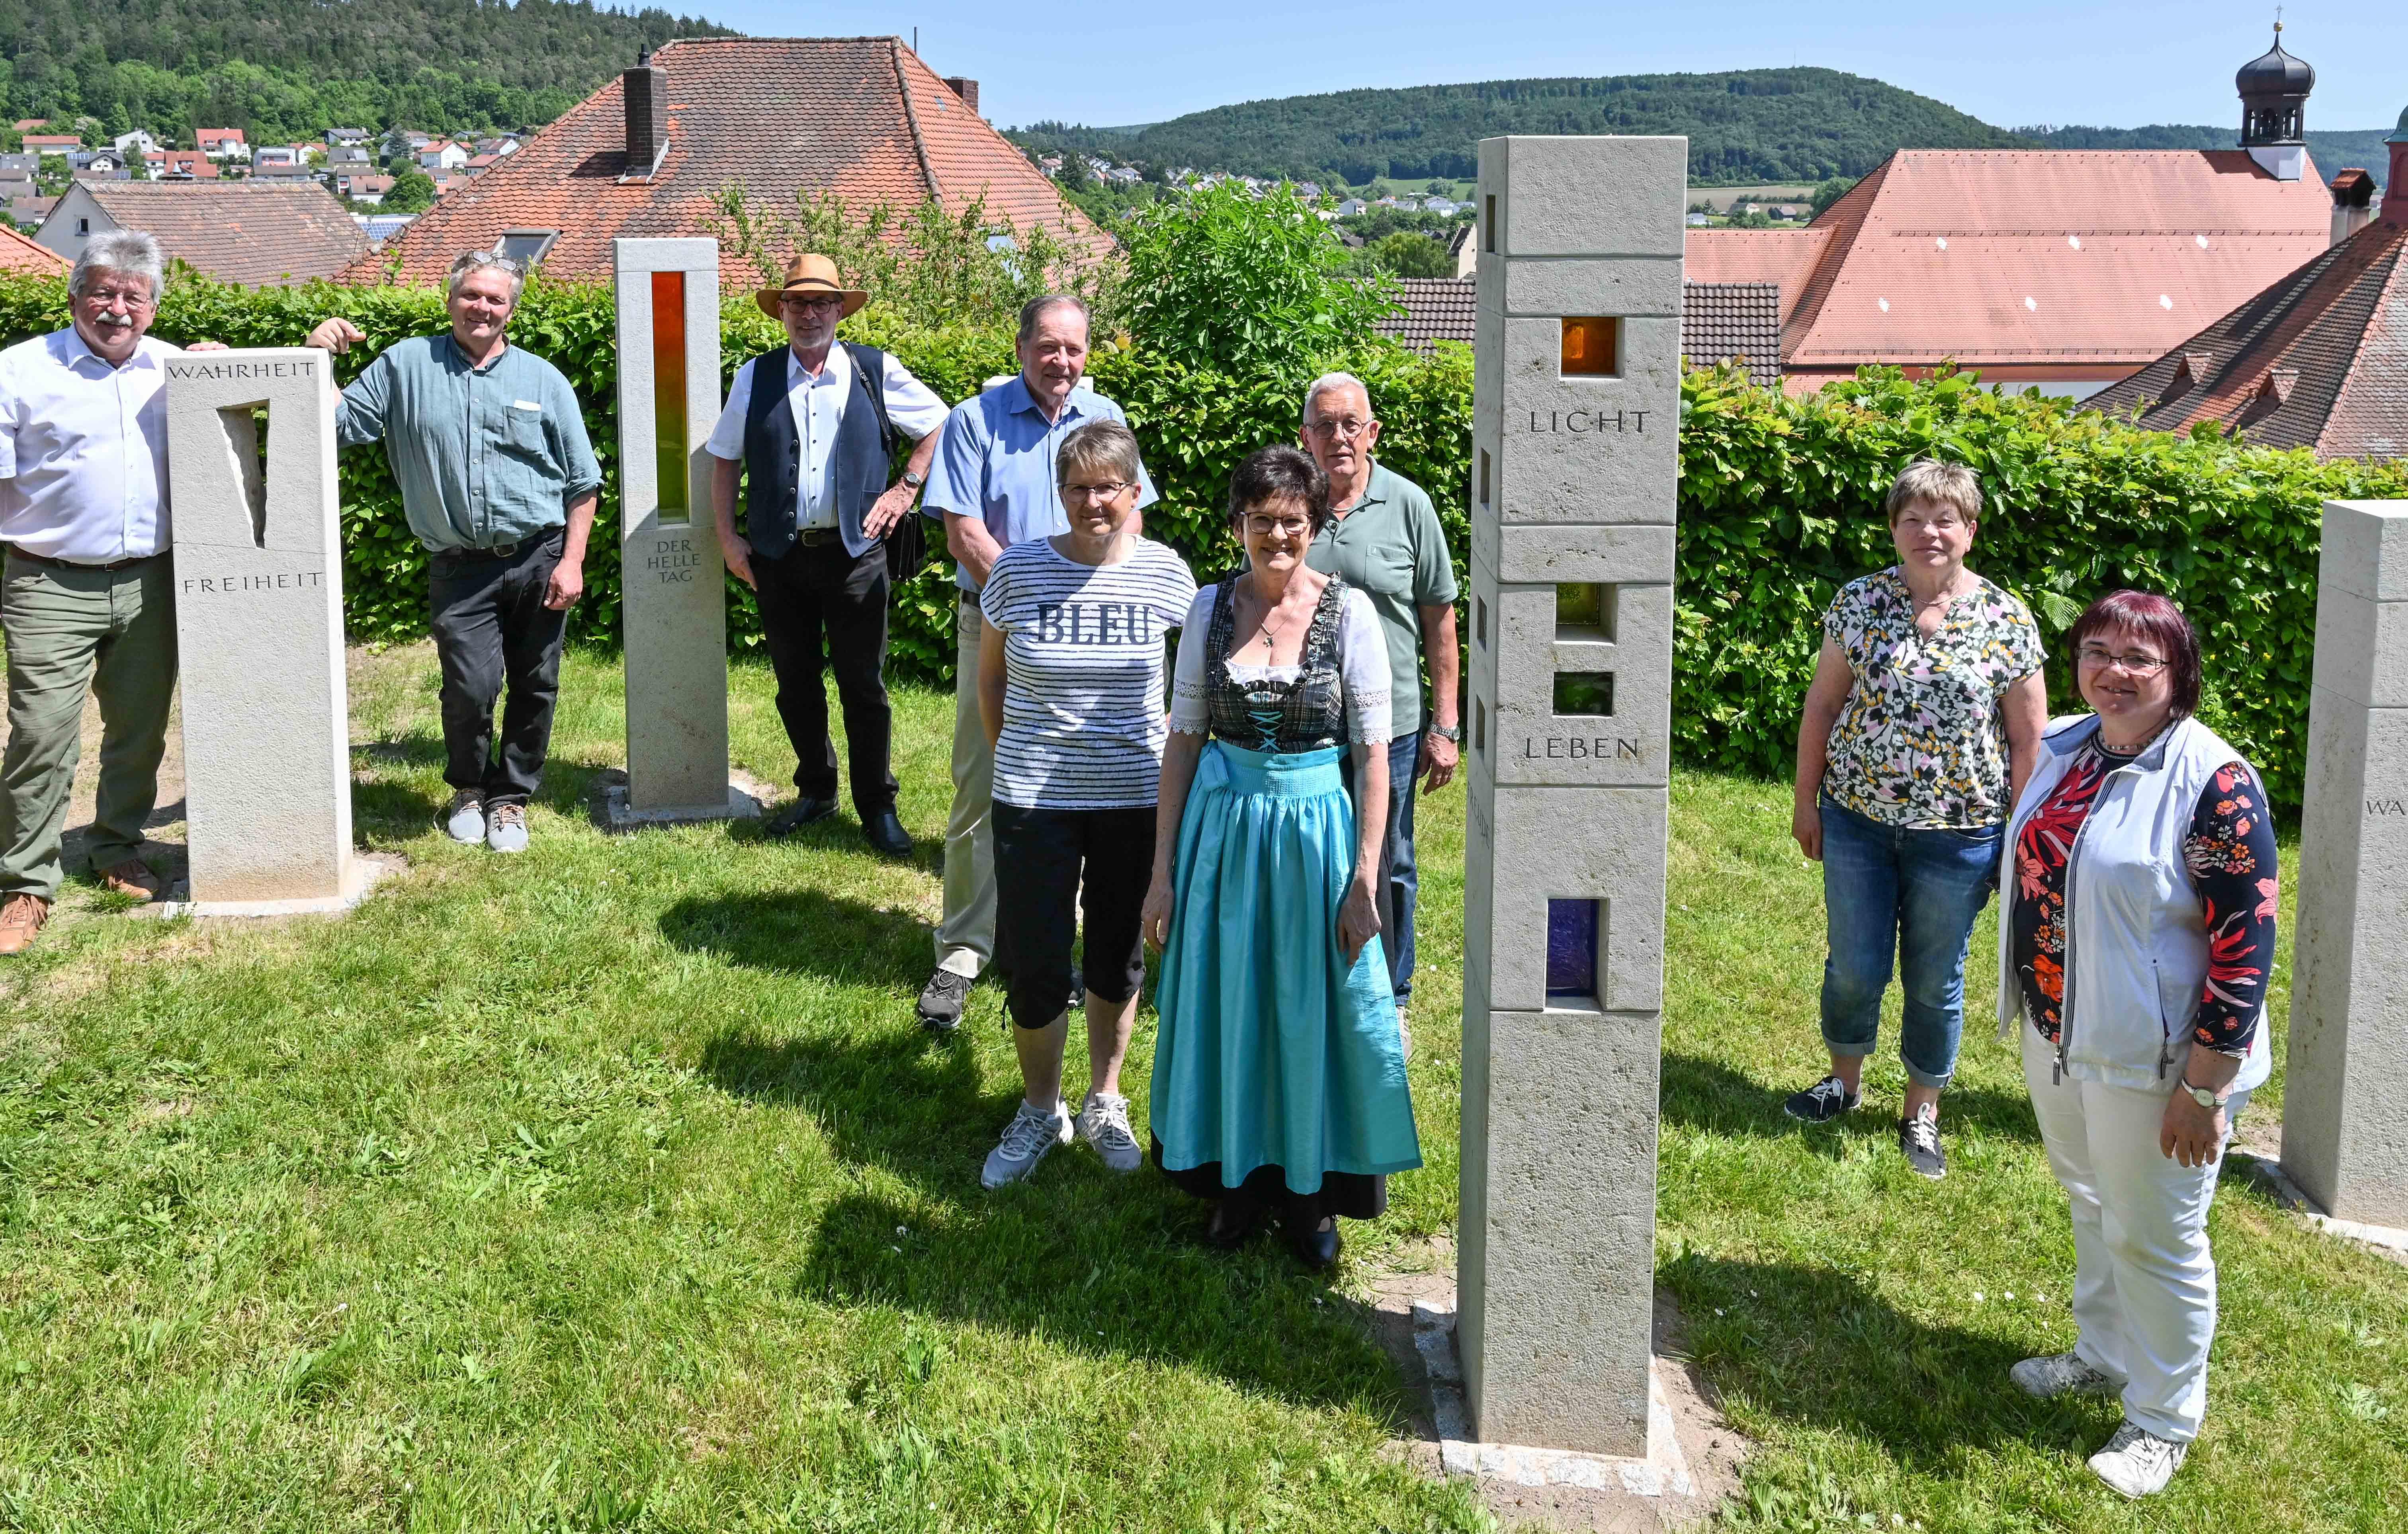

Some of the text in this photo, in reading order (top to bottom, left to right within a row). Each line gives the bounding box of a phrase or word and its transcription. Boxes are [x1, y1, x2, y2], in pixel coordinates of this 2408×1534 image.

[168, 362, 315, 379] WAHRHEIT
[1530, 409, 1650, 433] LICHT
[657, 539, 692, 553] DER
[647, 554, 701, 569] HELLE
[184, 572, 322, 594] FREIHEIT
[658, 570, 692, 583] TAG
[1037, 604, 1150, 646] BLEU
[1525, 738, 1638, 758] LEBEN
[1467, 780, 1490, 850] FREUDE
